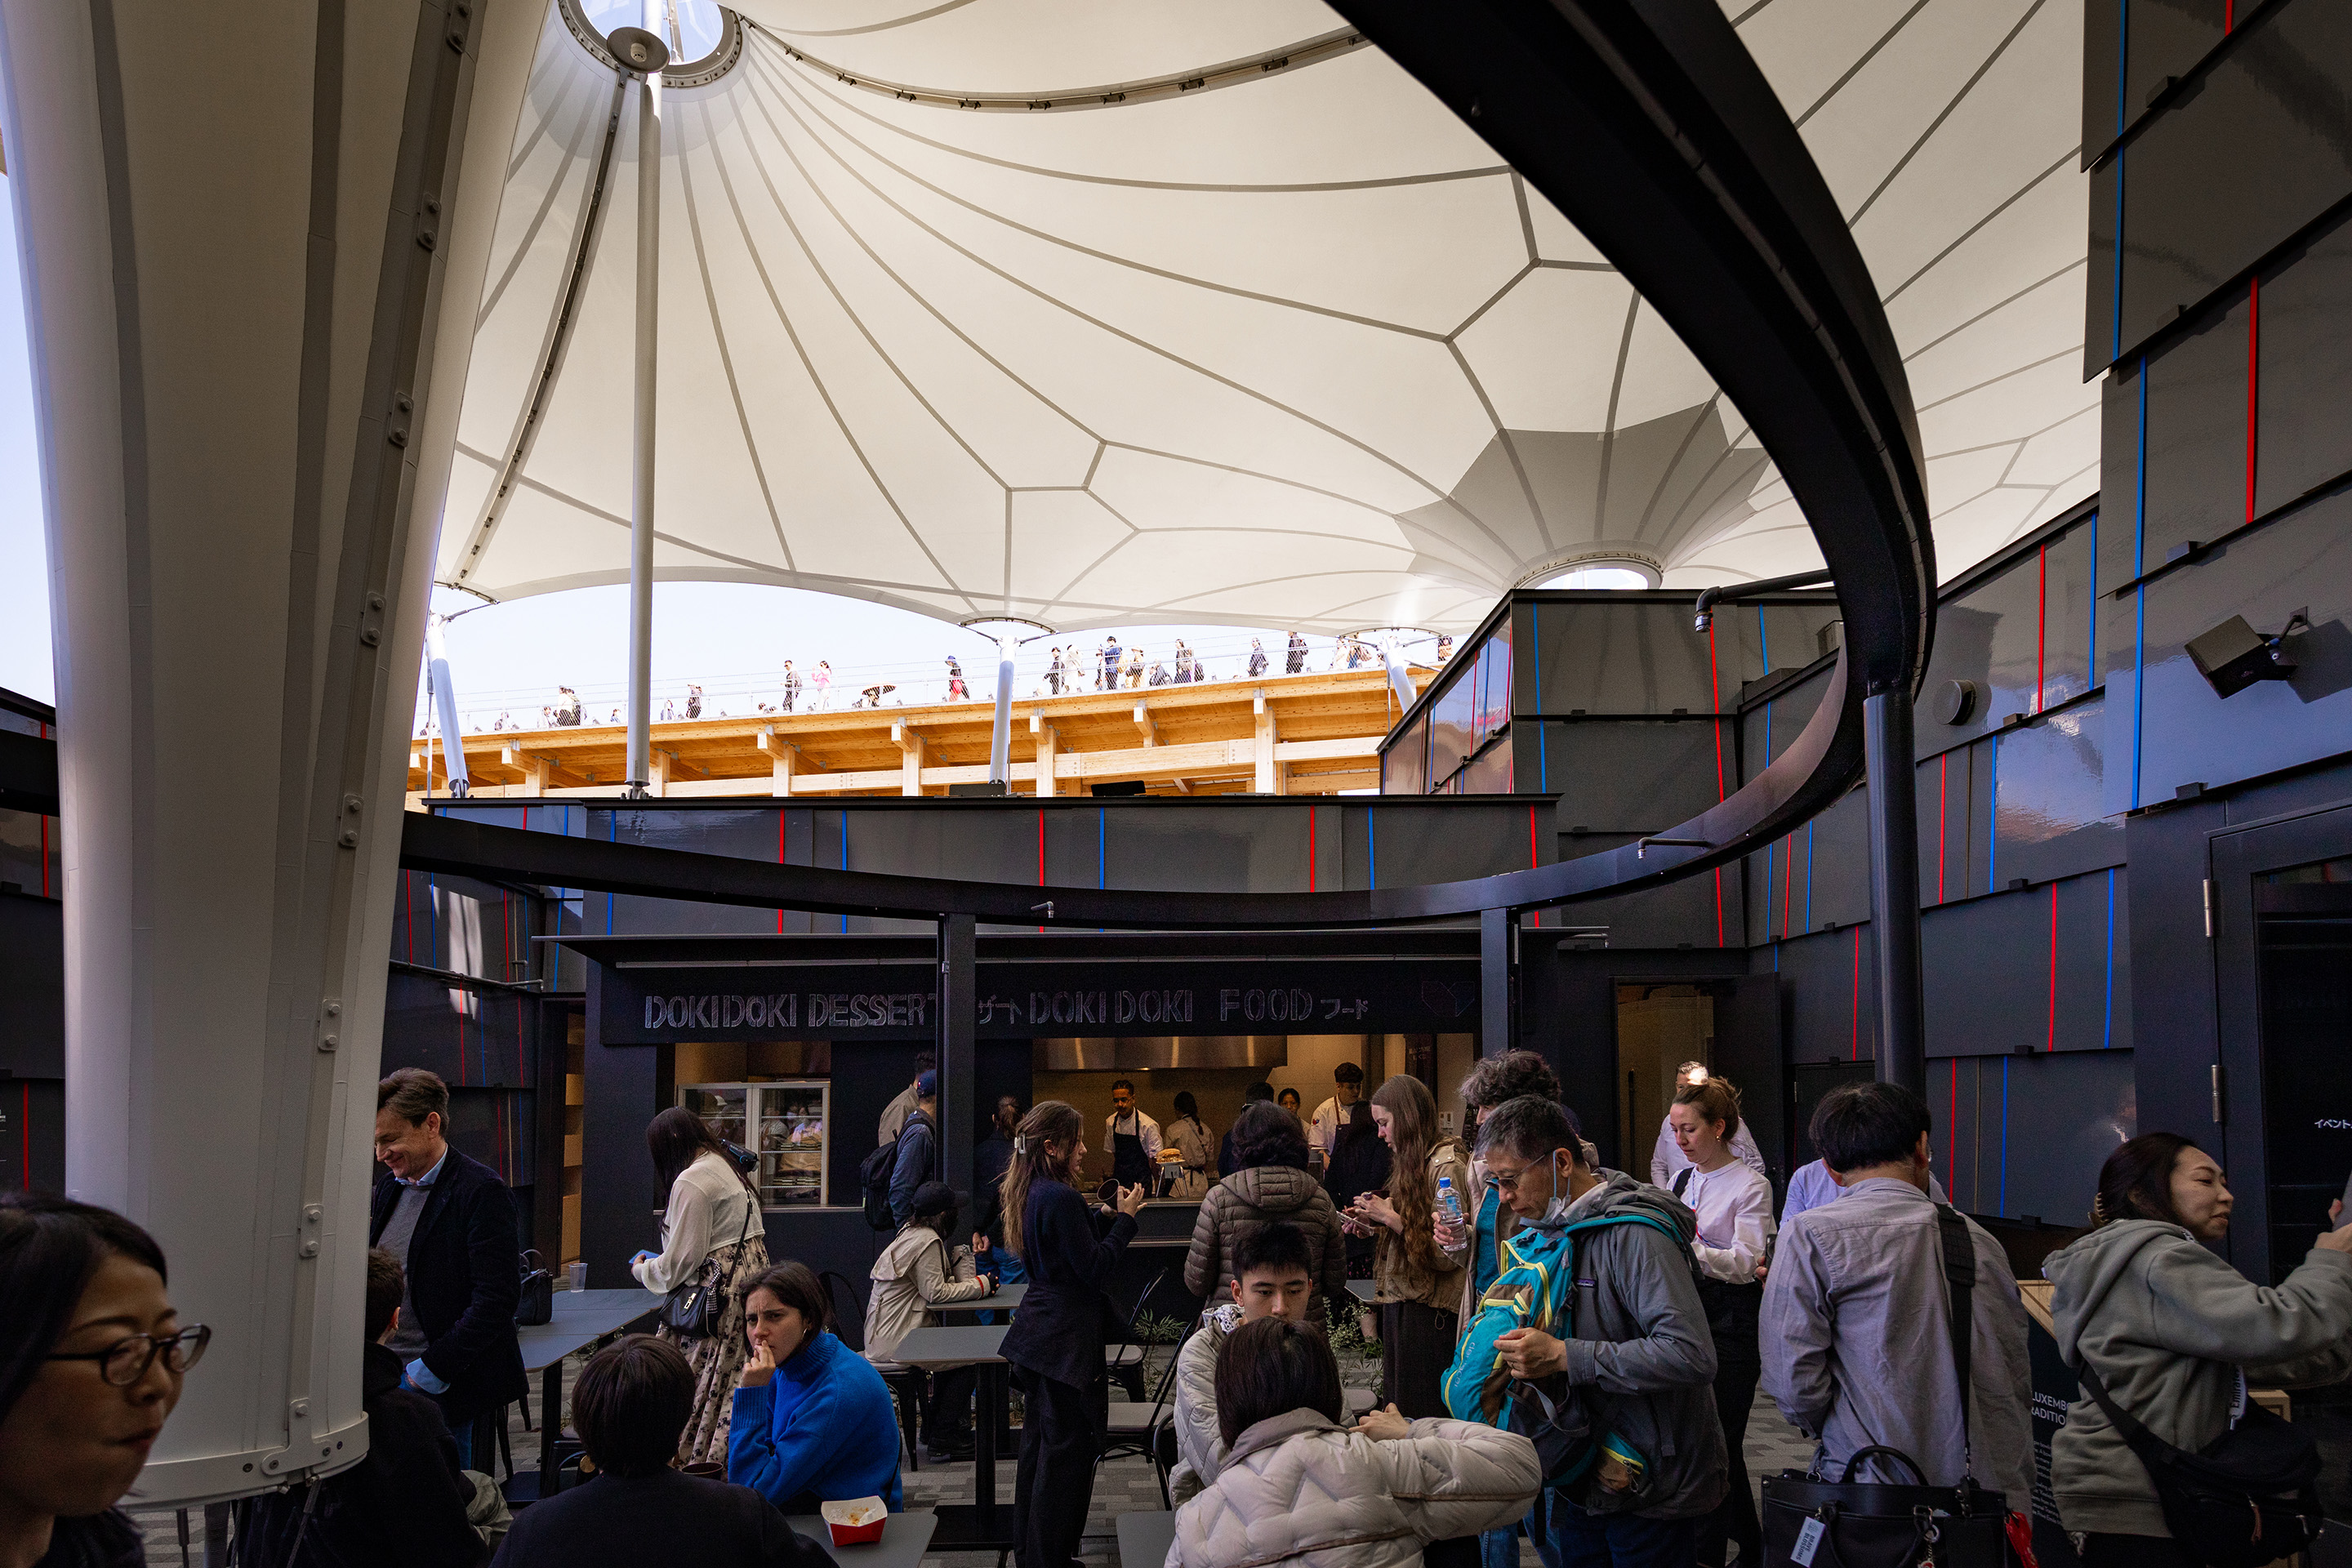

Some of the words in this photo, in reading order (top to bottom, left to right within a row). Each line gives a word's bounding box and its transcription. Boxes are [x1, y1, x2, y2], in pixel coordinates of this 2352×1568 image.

[808, 992, 937, 1027] DESSER
[1219, 988, 1313, 1022] FOOD
[1320, 998, 1369, 1020] フード
[2314, 1118, 2352, 1129] イベント
